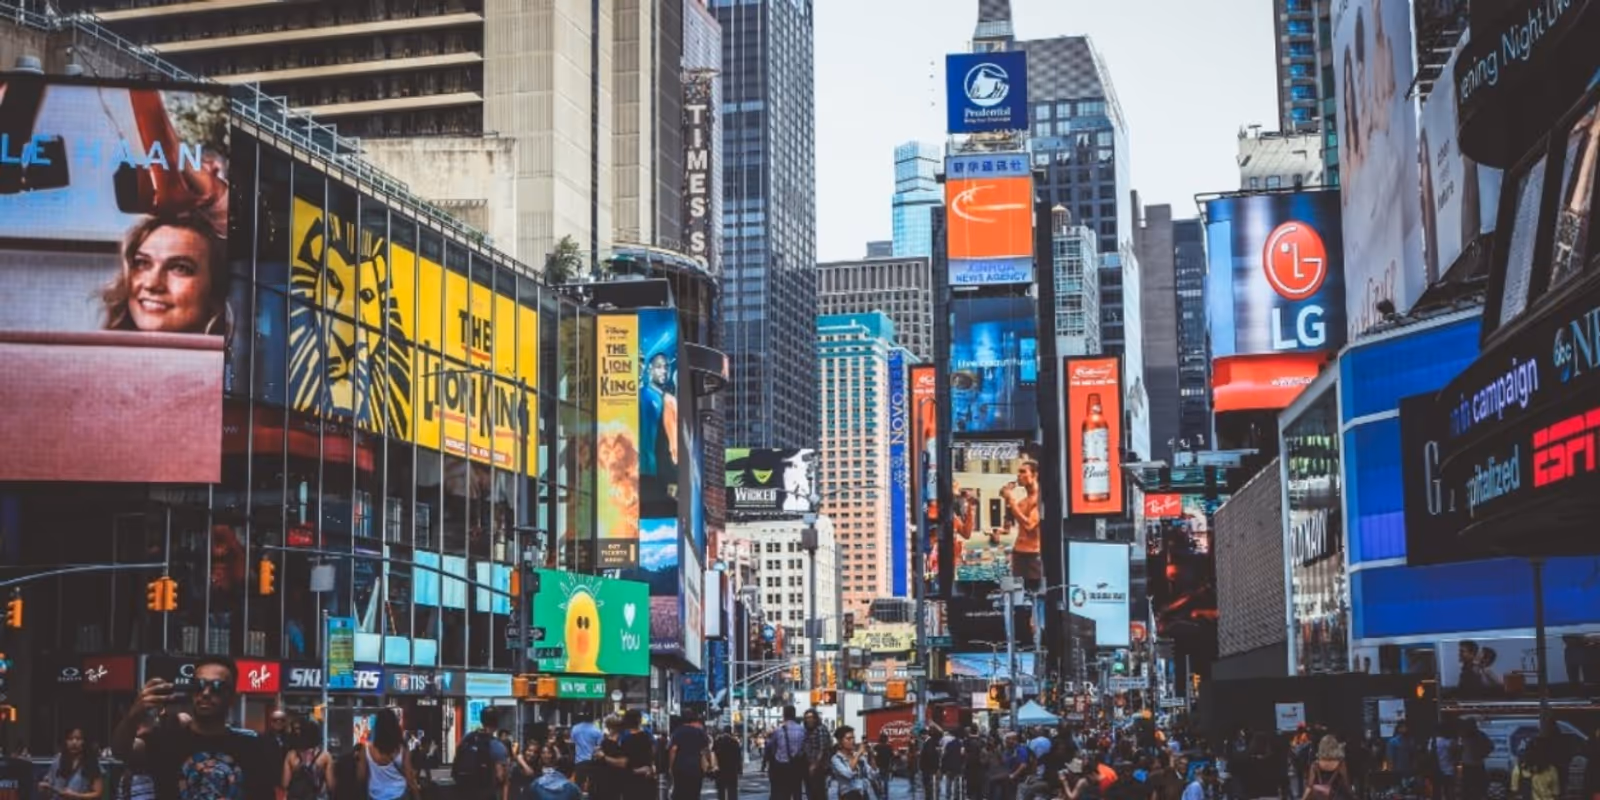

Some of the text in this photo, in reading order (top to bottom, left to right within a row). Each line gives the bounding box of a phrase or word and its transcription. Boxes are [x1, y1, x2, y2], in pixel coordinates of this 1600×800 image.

[1501, 7, 1545, 66] Night
[964, 106, 1011, 118] Prudential
[74, 138, 201, 171] HAAN
[685, 104, 708, 218] TIMES
[459, 309, 491, 353] THE
[1272, 305, 1326, 350] LG
[602, 356, 632, 374] LION
[606, 344, 627, 354] THE
[424, 339, 476, 421] LION
[600, 376, 637, 397] KING
[1472, 357, 1539, 421] campaign
[734, 487, 777, 502] WICKED
